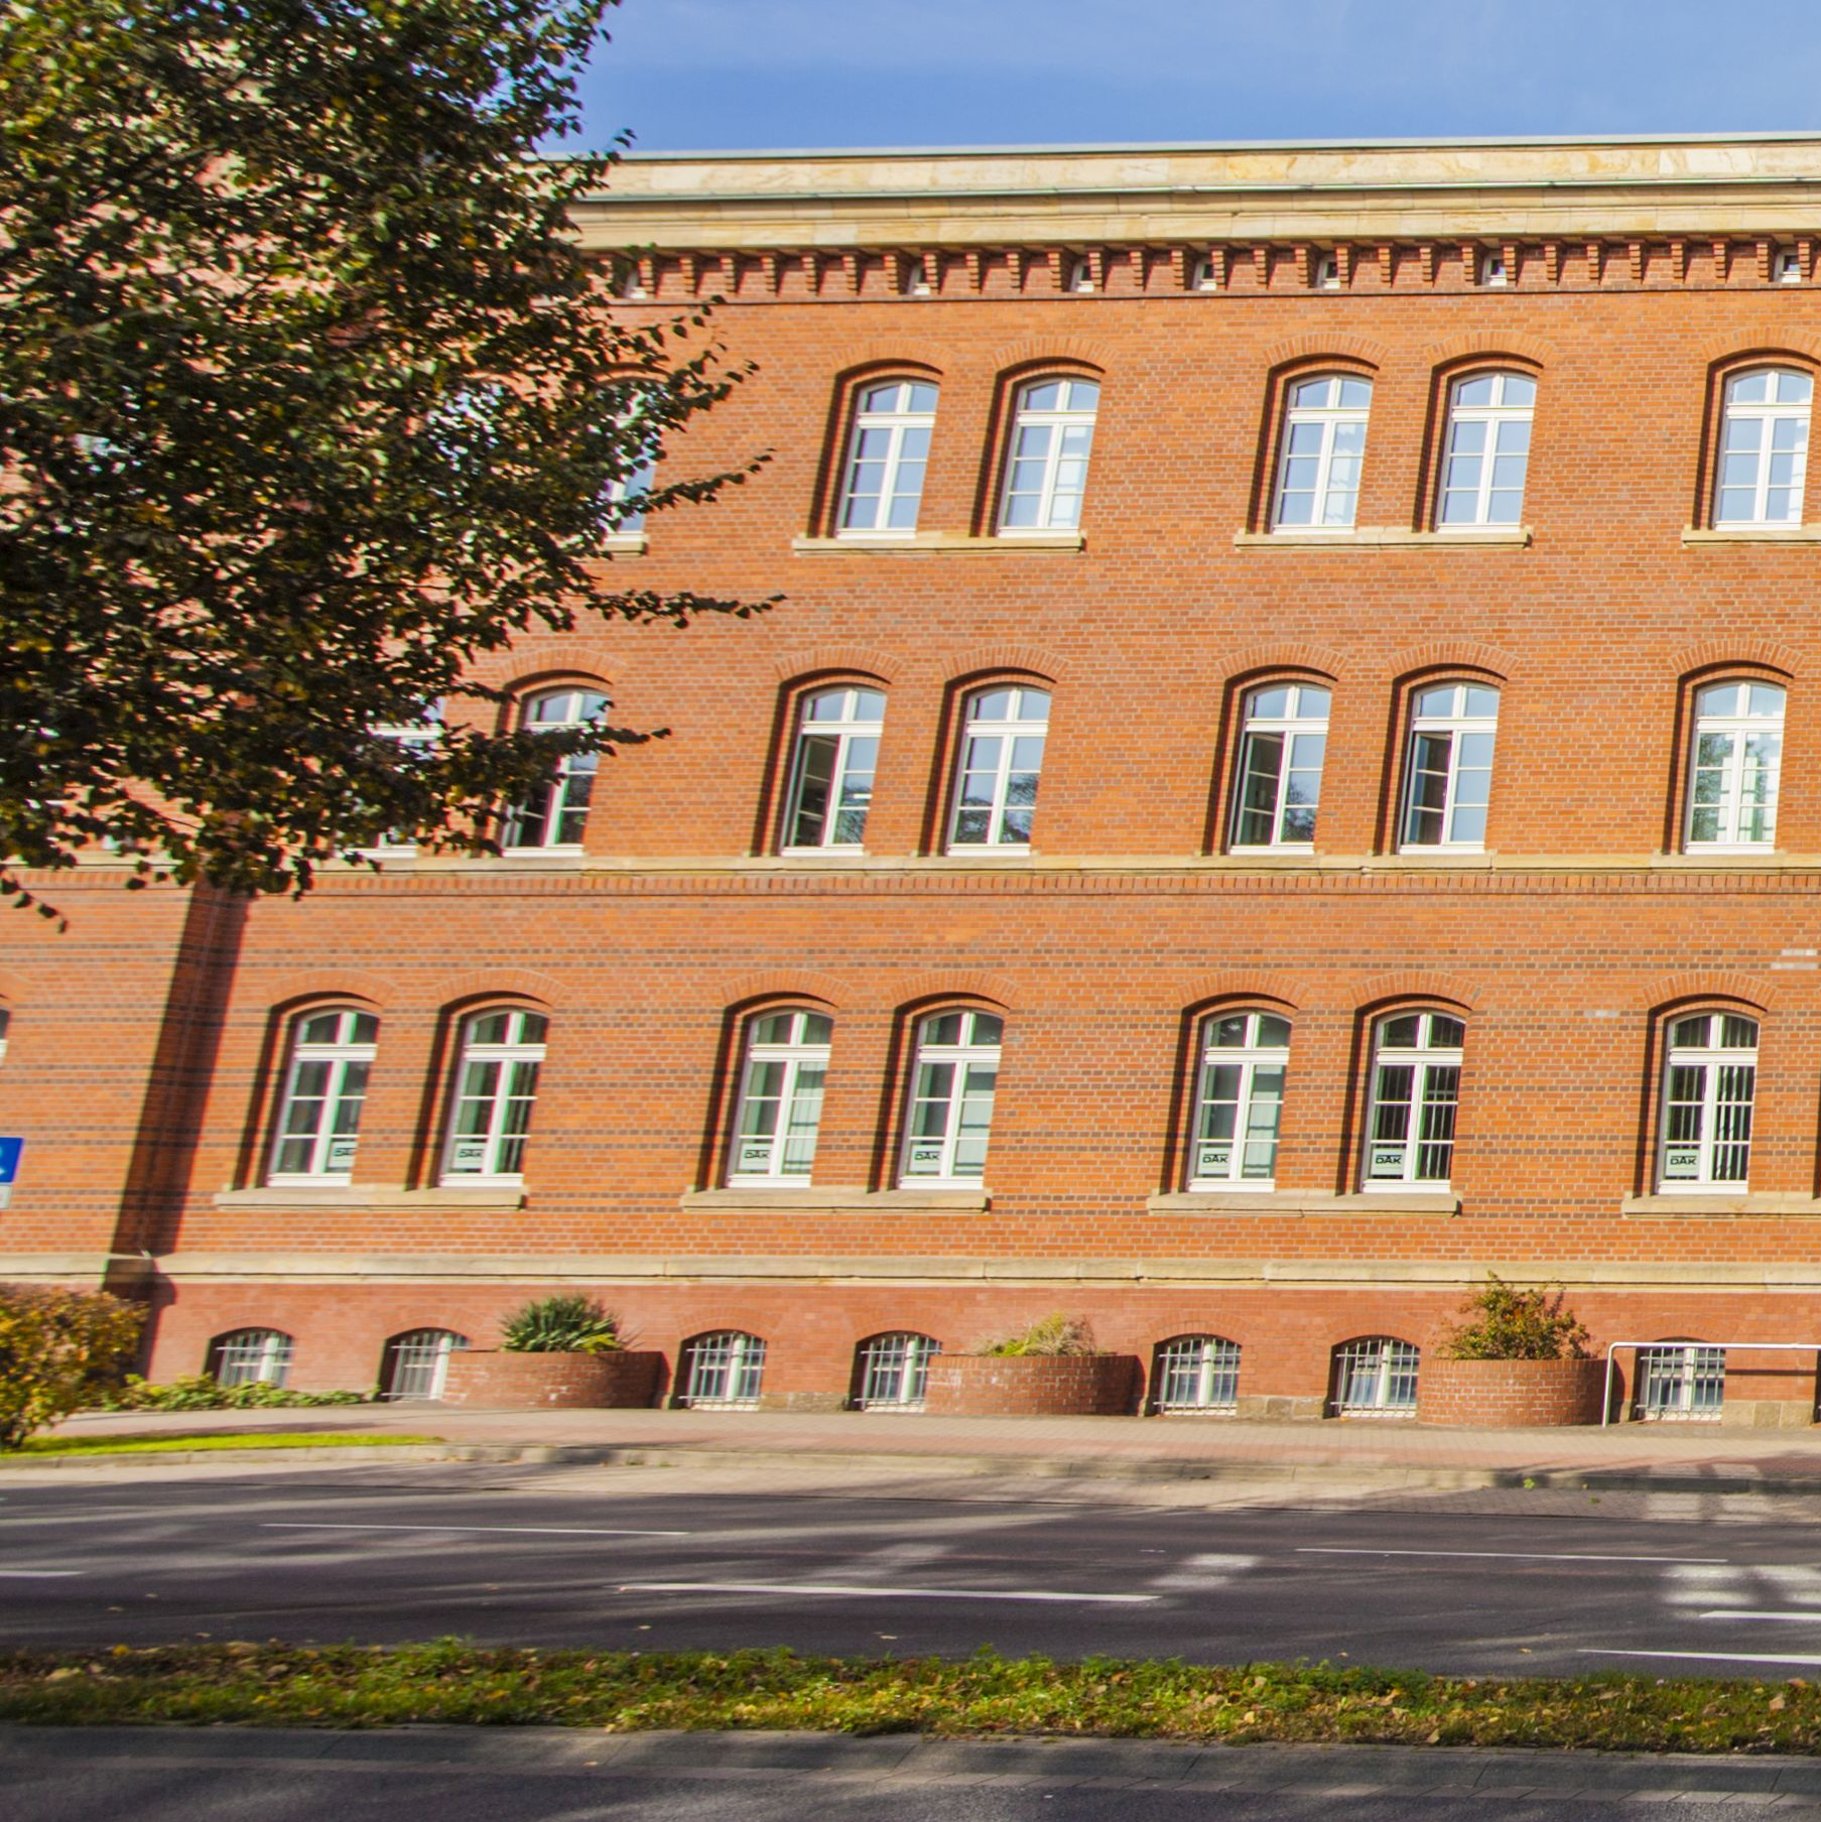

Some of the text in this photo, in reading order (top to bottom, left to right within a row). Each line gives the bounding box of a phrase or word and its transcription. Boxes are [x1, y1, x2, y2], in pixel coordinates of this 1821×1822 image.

[1202, 1153, 1229, 1163] DAK
[1375, 1154, 1402, 1164] DAK
[1670, 1155, 1697, 1165] DAK
